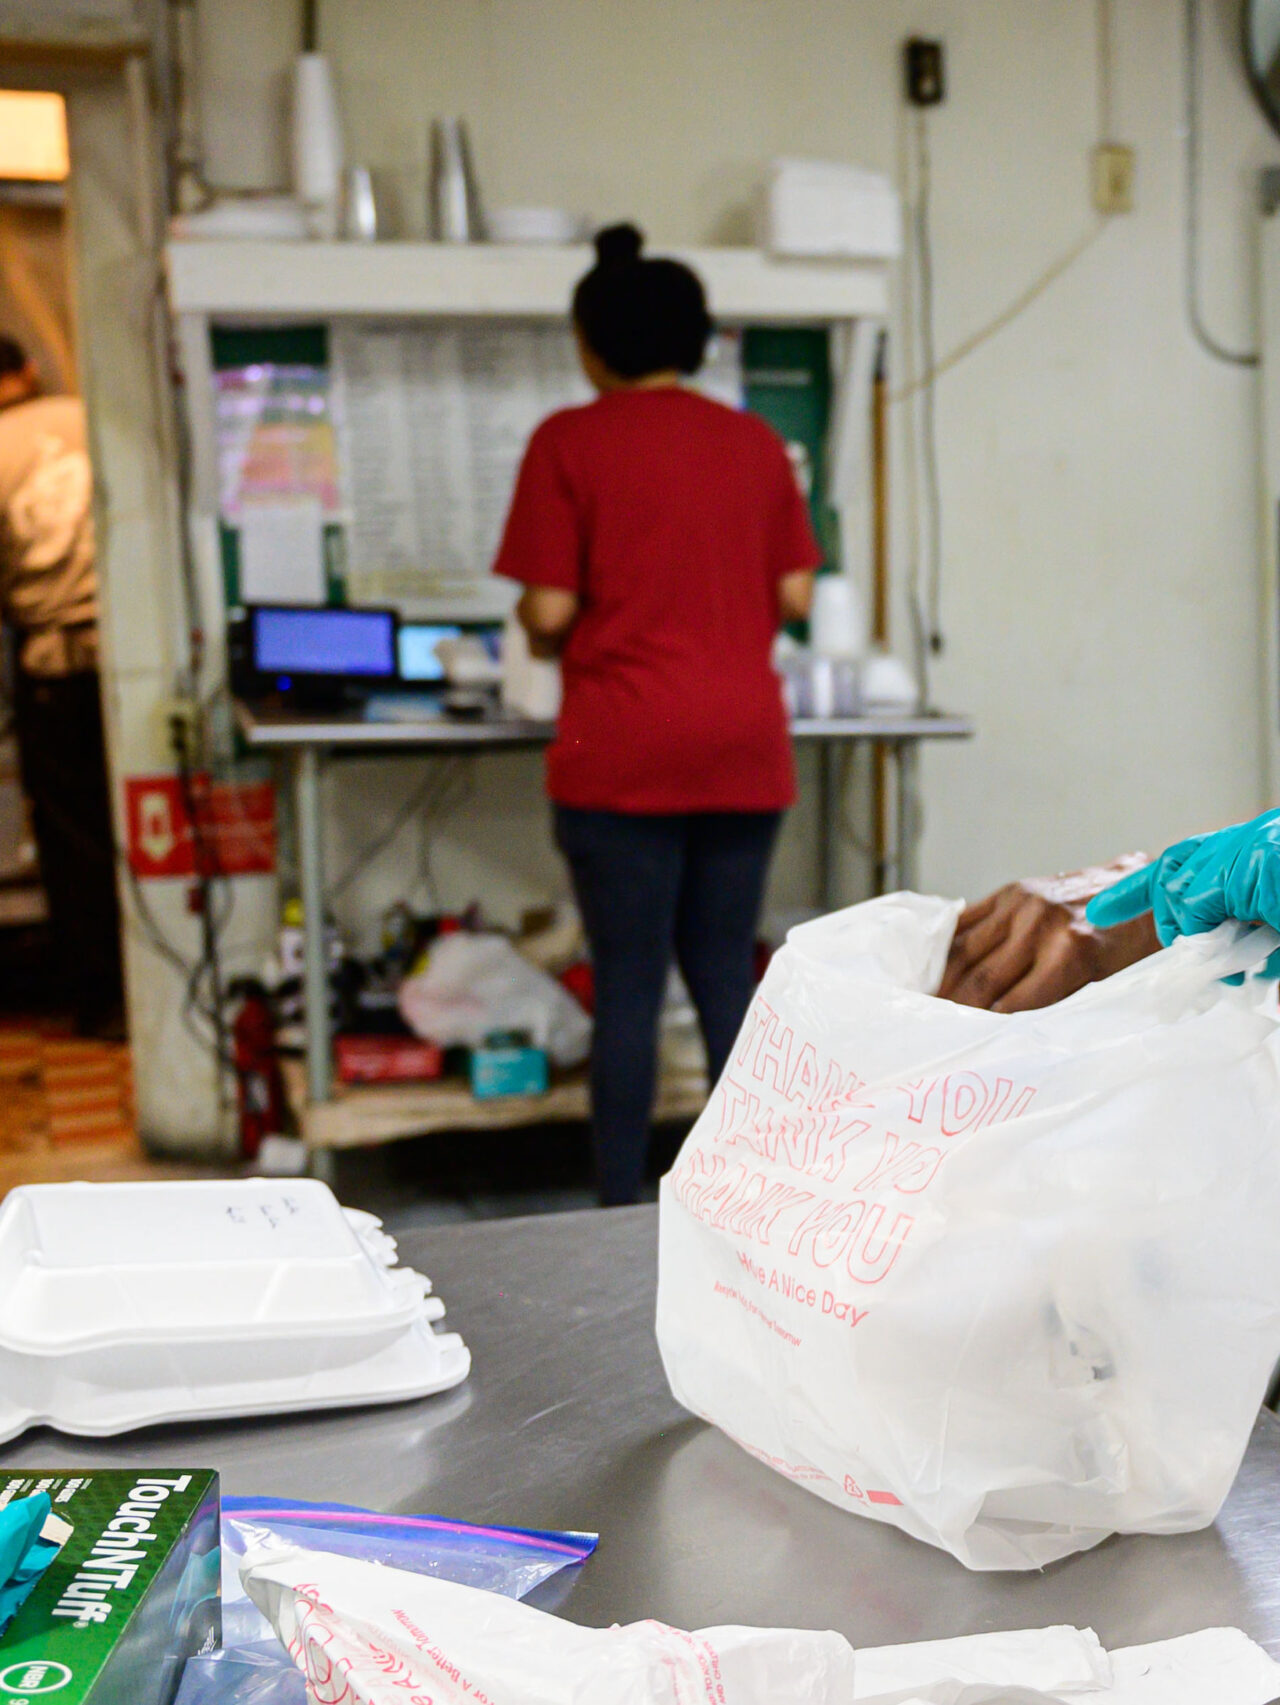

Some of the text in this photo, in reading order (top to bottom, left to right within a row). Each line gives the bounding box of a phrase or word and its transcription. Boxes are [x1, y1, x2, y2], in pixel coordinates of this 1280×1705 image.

[737, 996, 876, 1111] THANK
[853, 1131, 947, 1194] YO
[788, 1199, 915, 1284] YOU
[768, 1268, 780, 1293] A
[782, 1272, 817, 1308] Nice
[821, 1290, 870, 1328] Day
[52, 1474, 193, 1623] TouchNTuff
[391, 1609, 432, 1651] Tomorrow
[18, 1665, 49, 1689] NBR
[427, 1646, 462, 1684] Better
